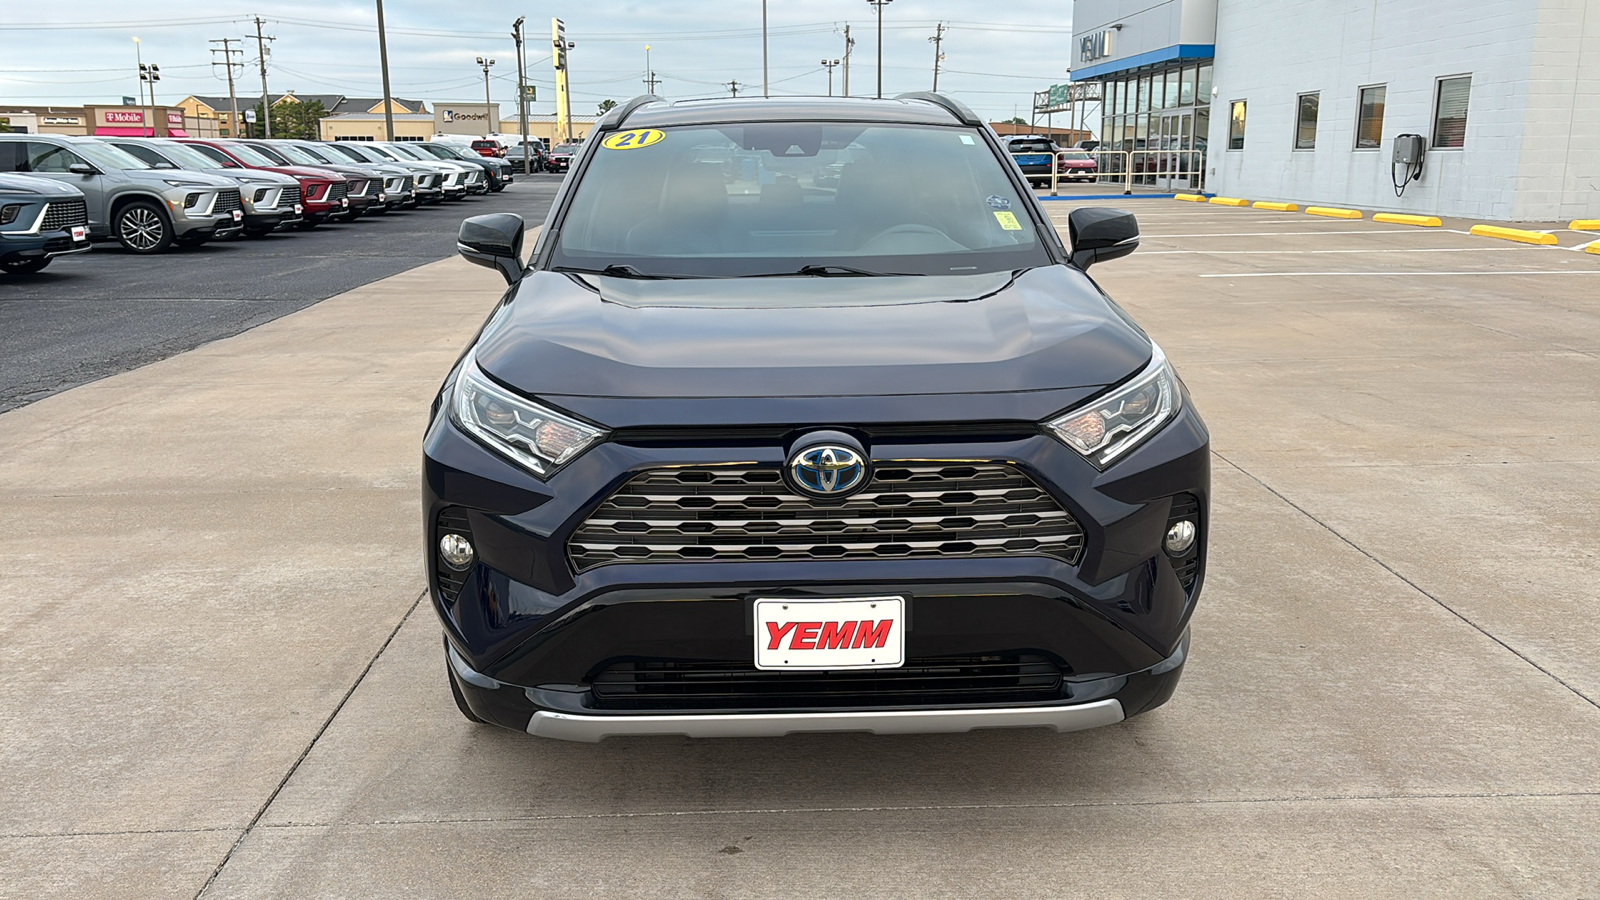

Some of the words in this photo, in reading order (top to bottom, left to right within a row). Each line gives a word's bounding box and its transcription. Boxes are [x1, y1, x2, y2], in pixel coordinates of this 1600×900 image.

[114, 112, 141, 122] Mobile
[614, 130, 651, 147] 21
[765, 619, 894, 650] YEMM
